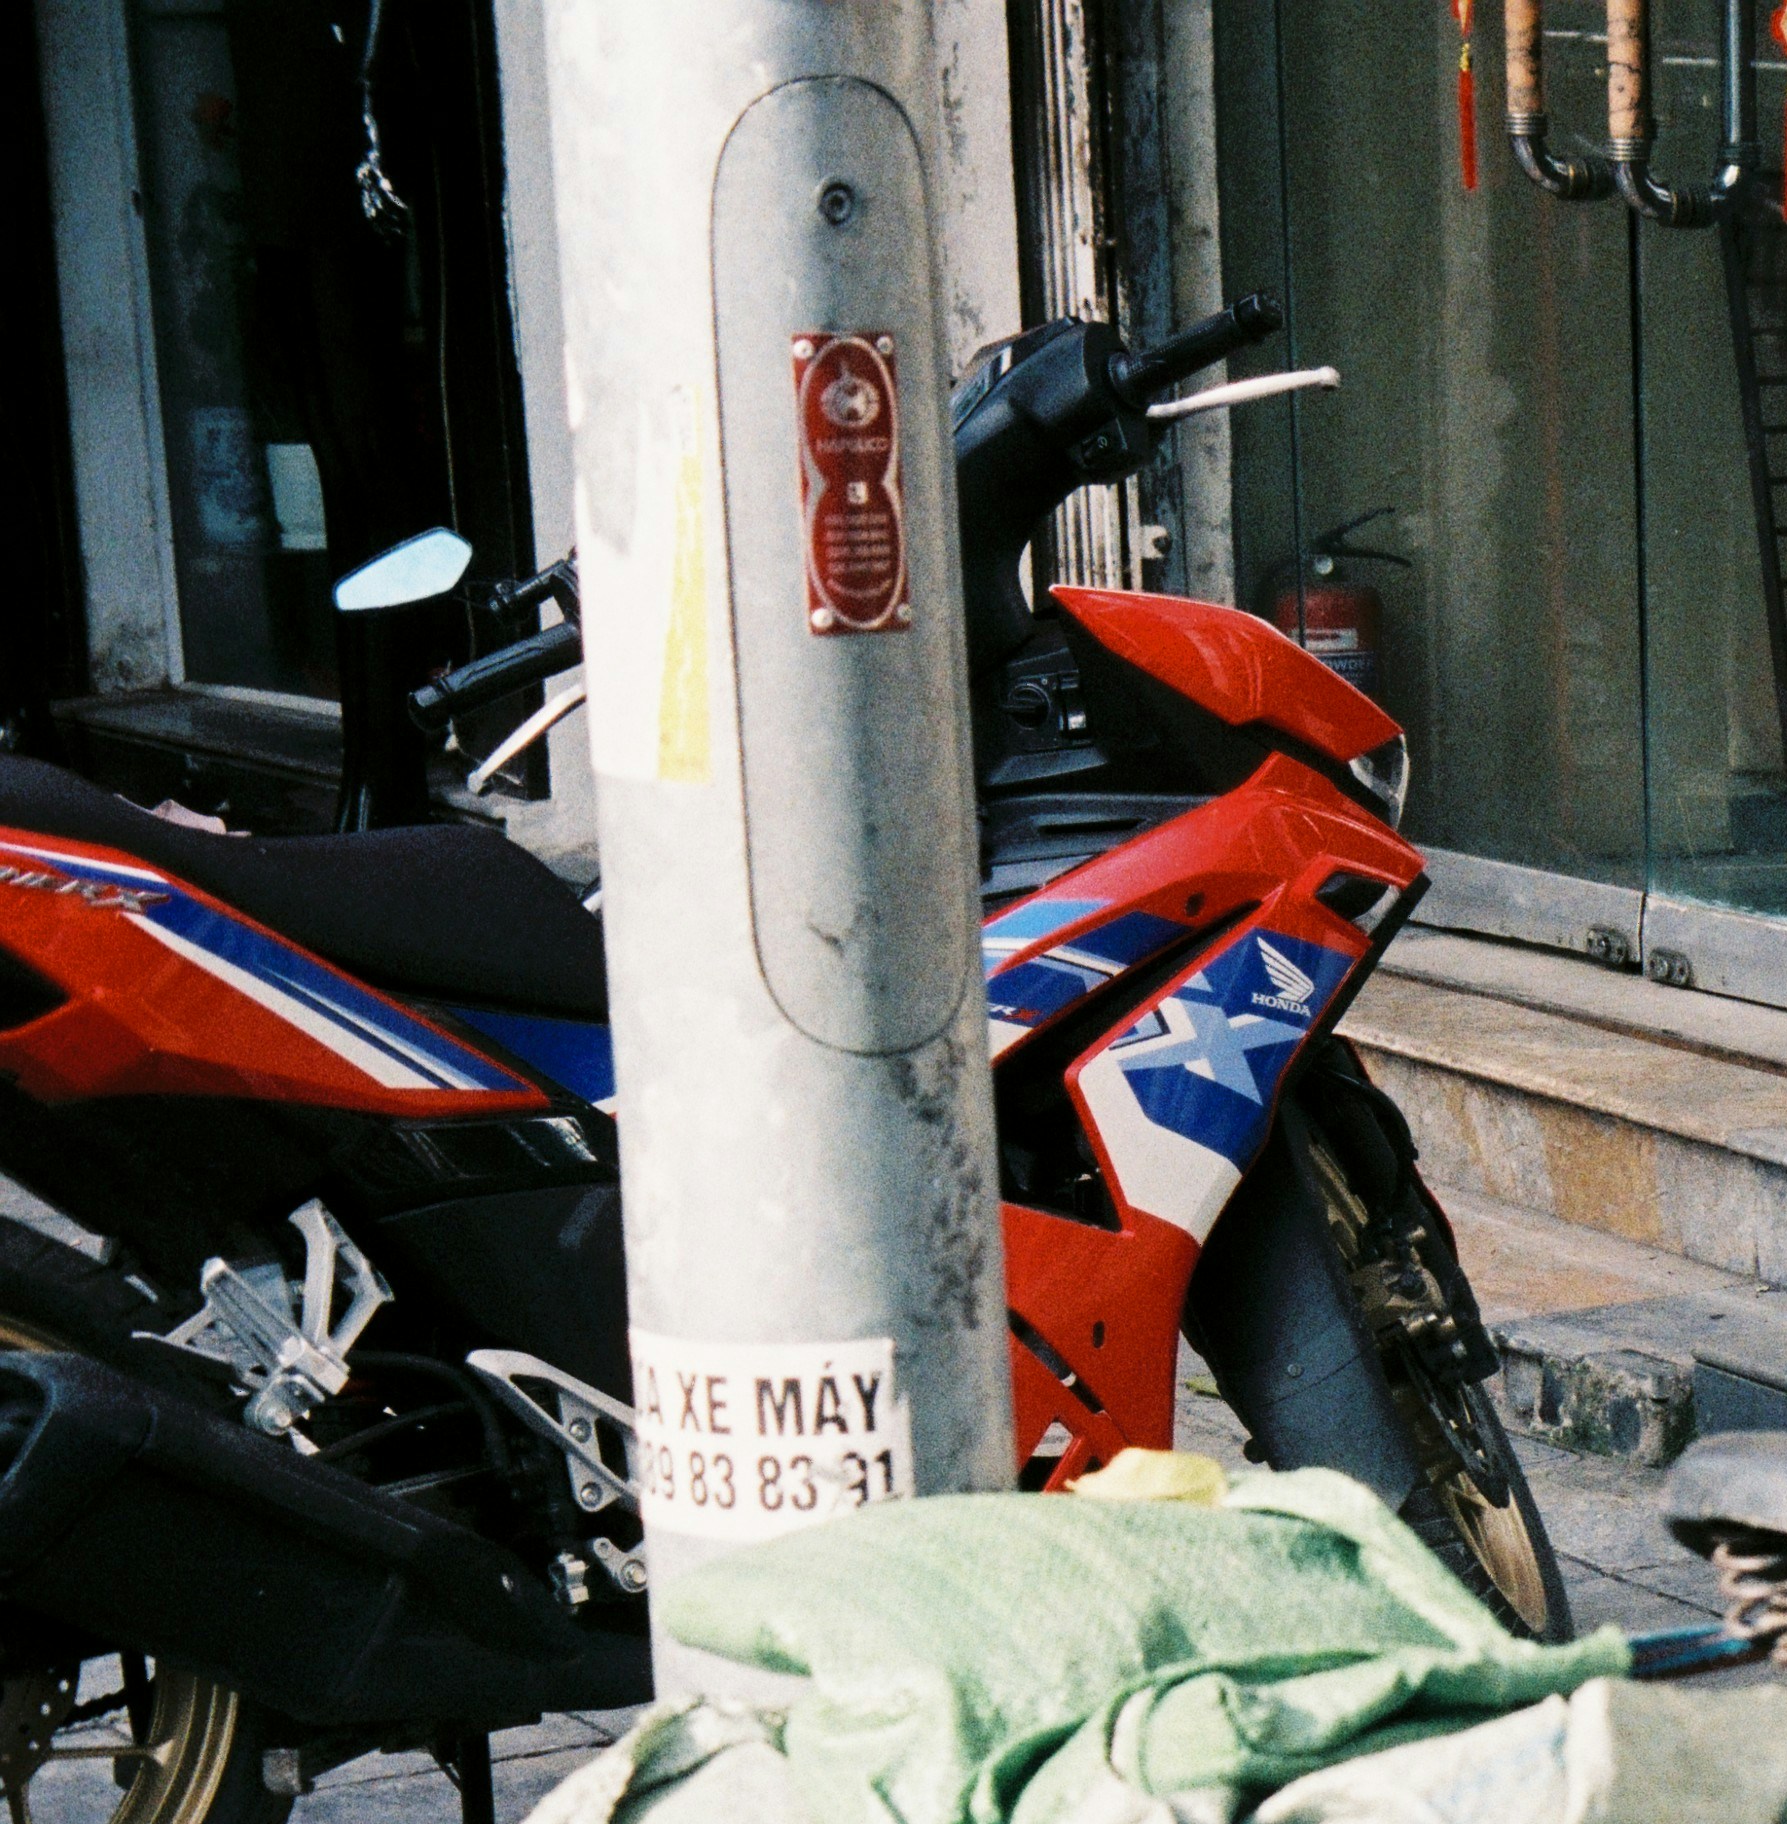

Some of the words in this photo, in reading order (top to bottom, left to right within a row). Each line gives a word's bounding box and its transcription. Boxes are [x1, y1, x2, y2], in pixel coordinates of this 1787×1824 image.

[1251, 992, 1311, 1017] HONDA
[677, 1370, 732, 1435] XE
[754, 1361, 882, 1436] MÁY
[690, 1450, 736, 1510] 83
[758, 1454, 818, 1512] 83
